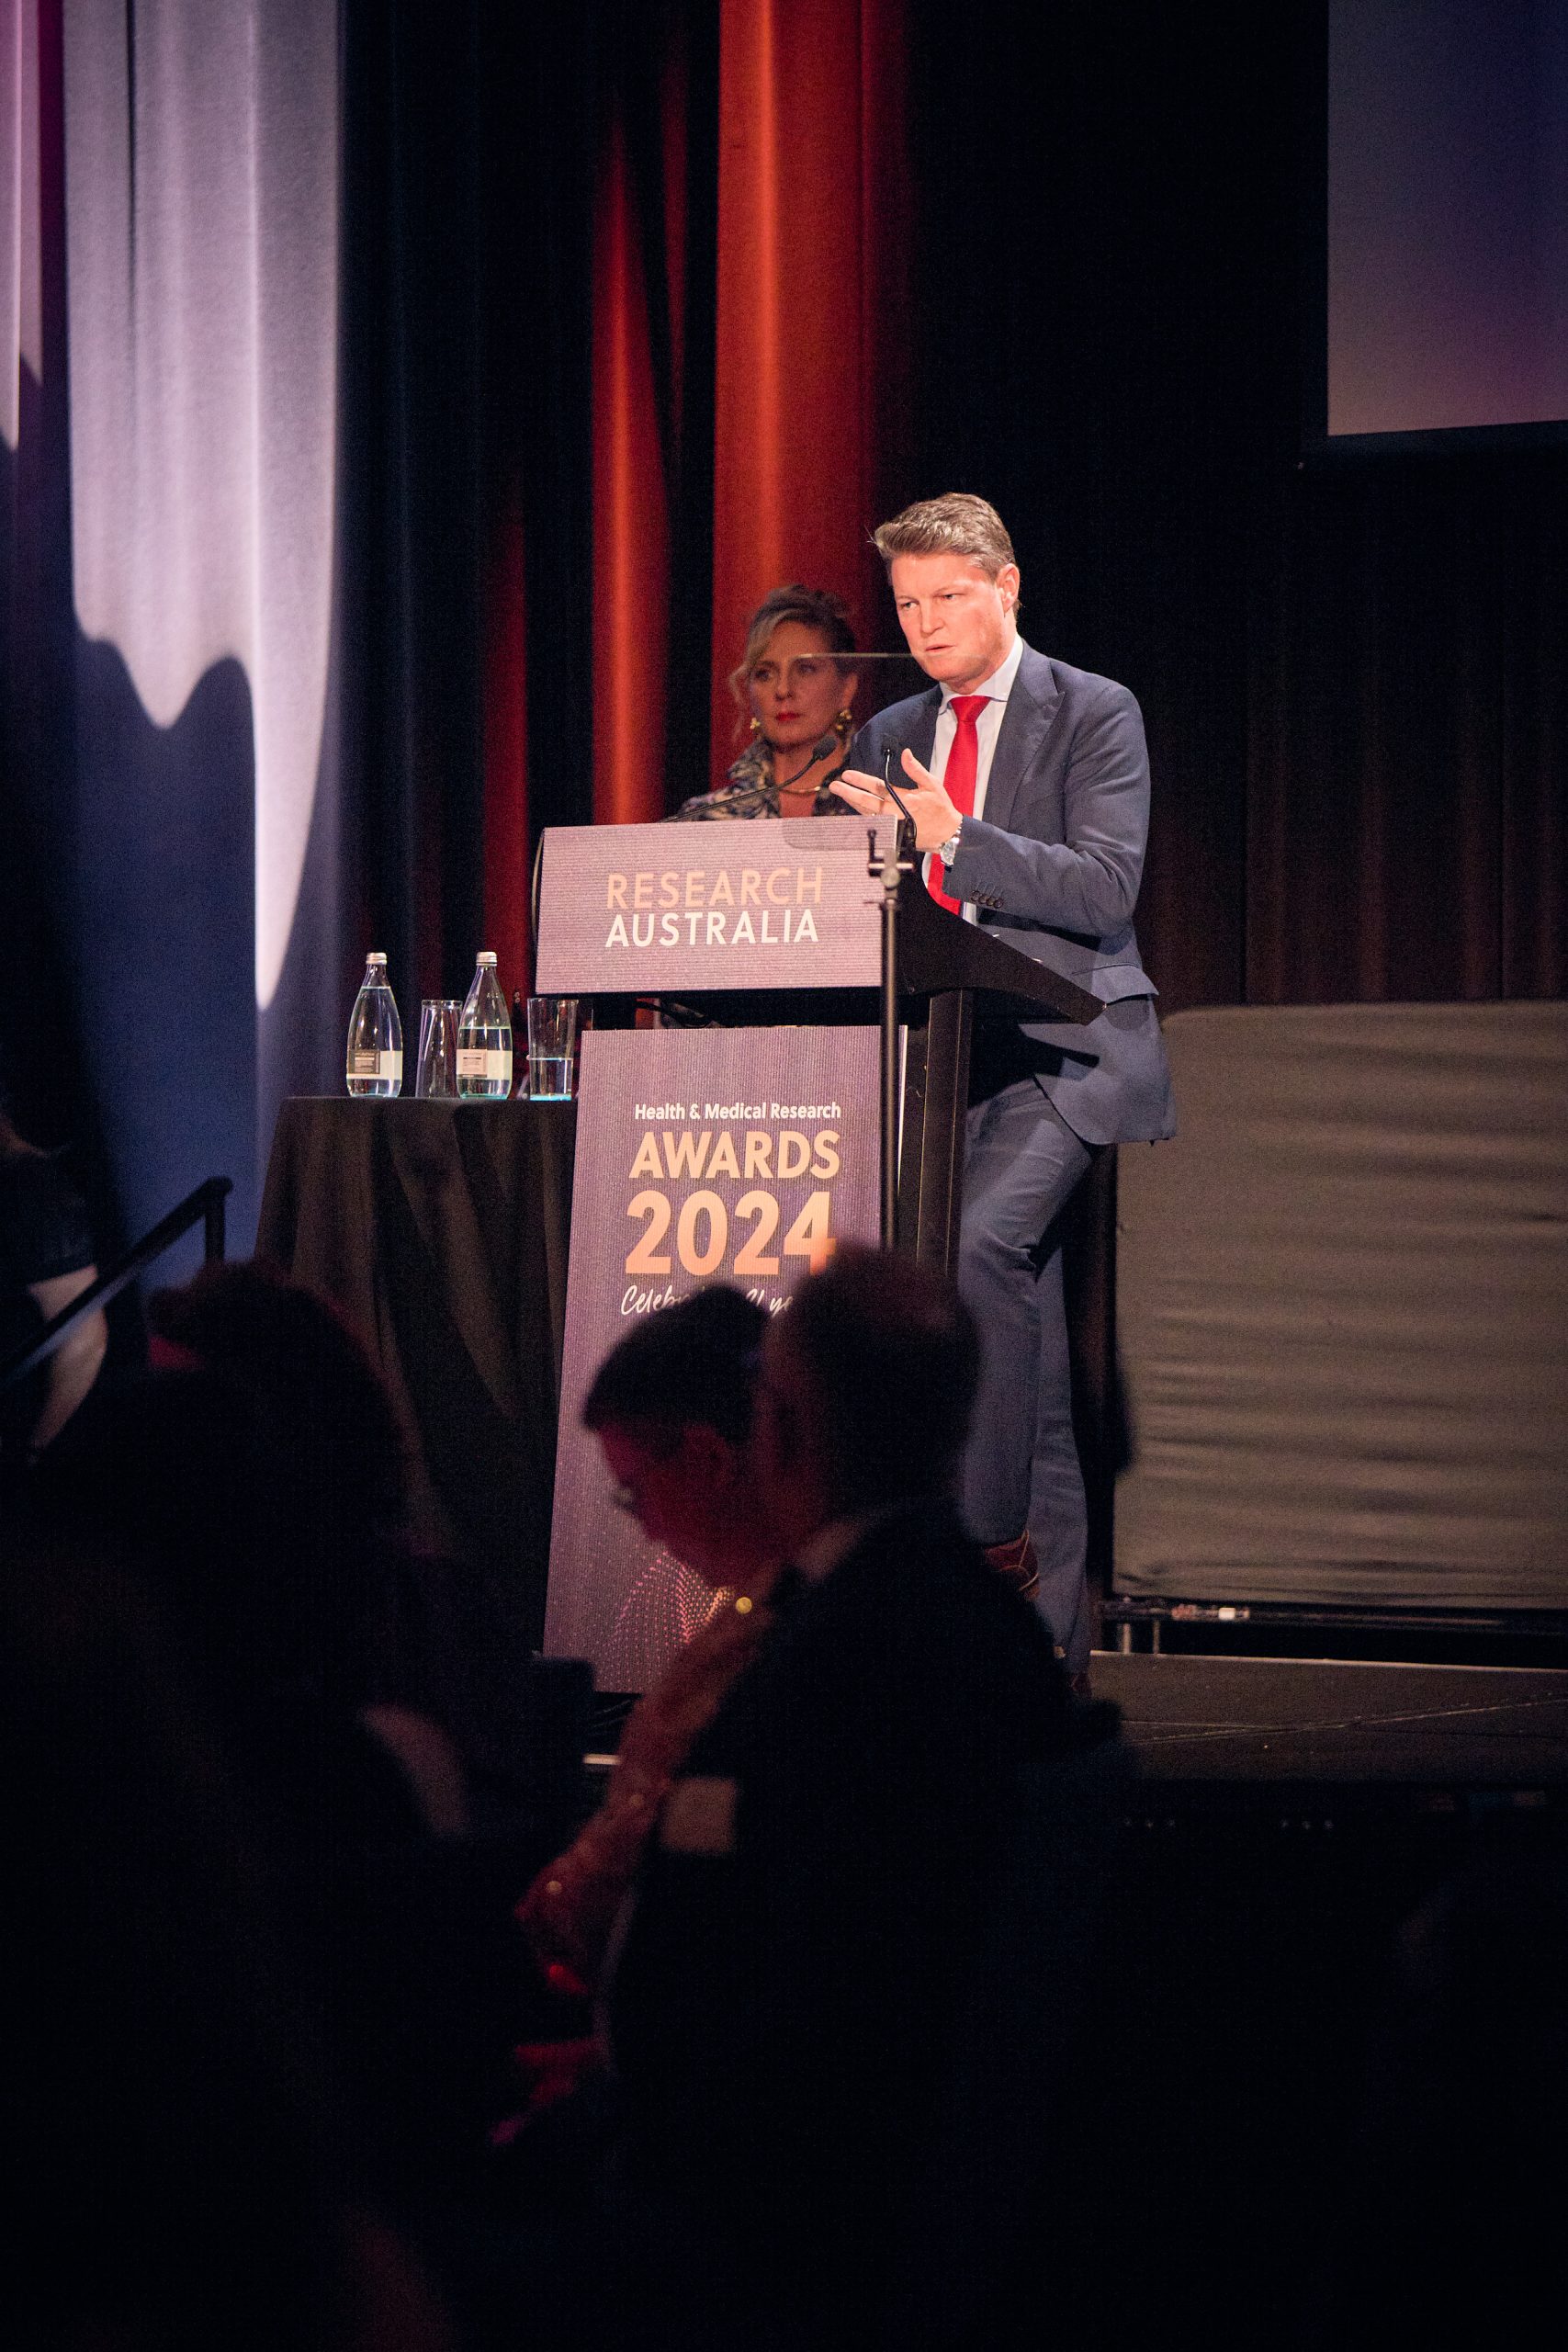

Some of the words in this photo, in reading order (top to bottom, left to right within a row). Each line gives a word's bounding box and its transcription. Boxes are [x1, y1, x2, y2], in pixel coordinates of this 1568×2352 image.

[606, 866, 823, 910] RESEARCH
[605, 909, 818, 947] AUSTRALIA
[635, 1103, 685, 1120] Health
[689, 1103, 701, 1119] &
[705, 1102, 767, 1119] Medical
[771, 1102, 841, 1119] Research
[628, 1130, 840, 1180] AWARDS
[626, 1190, 836, 1276] 2024
